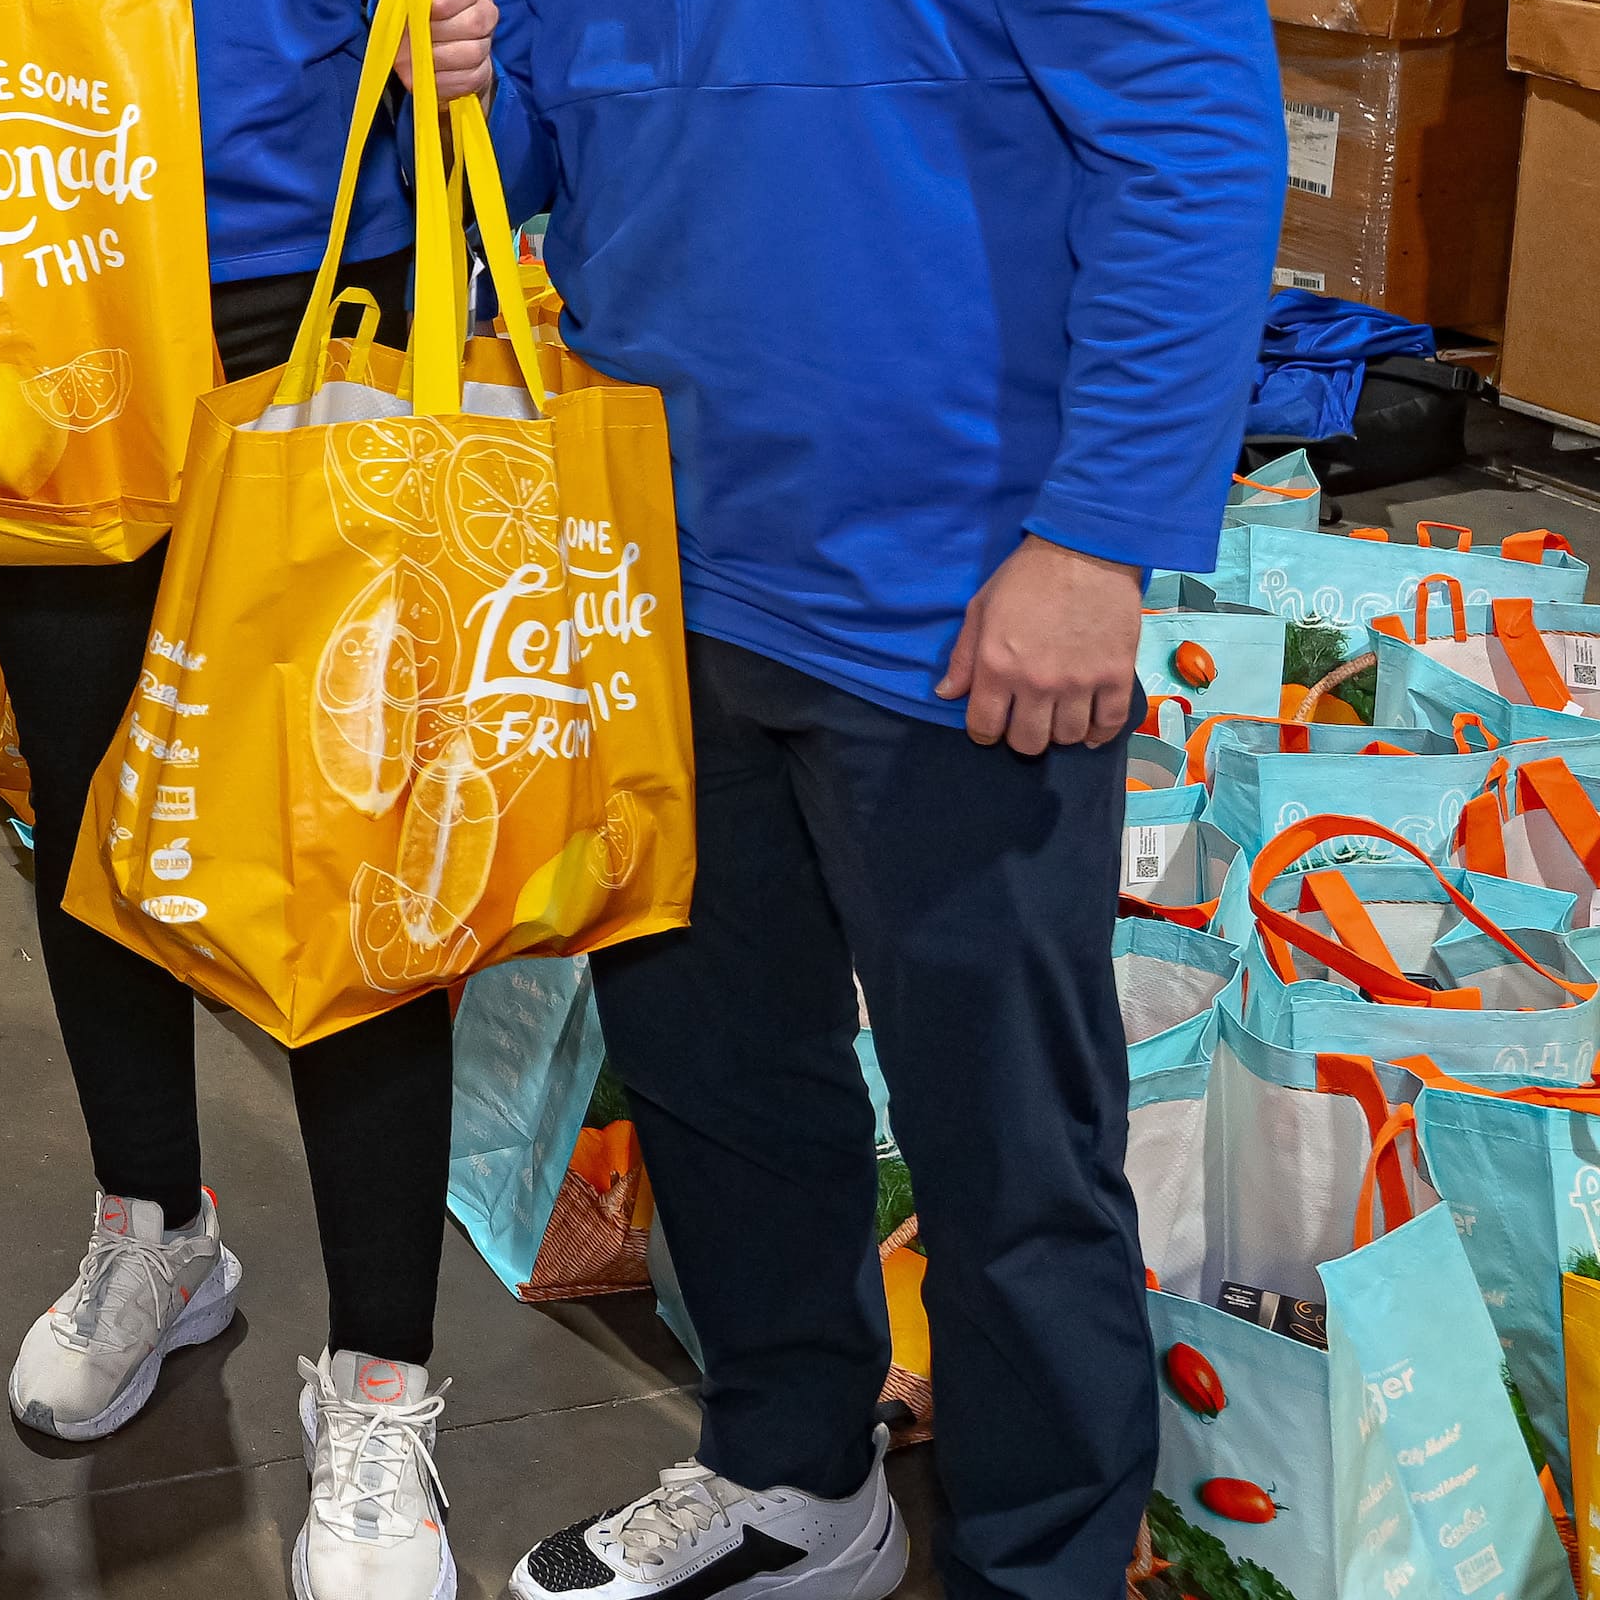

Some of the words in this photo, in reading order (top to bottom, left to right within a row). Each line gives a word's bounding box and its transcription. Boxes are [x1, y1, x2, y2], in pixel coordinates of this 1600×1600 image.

[19, 61, 109, 114] SOME
[28, 229, 126, 289] THIS
[494, 711, 590, 760] FROM
[144, 898, 199, 921] Ralphs
